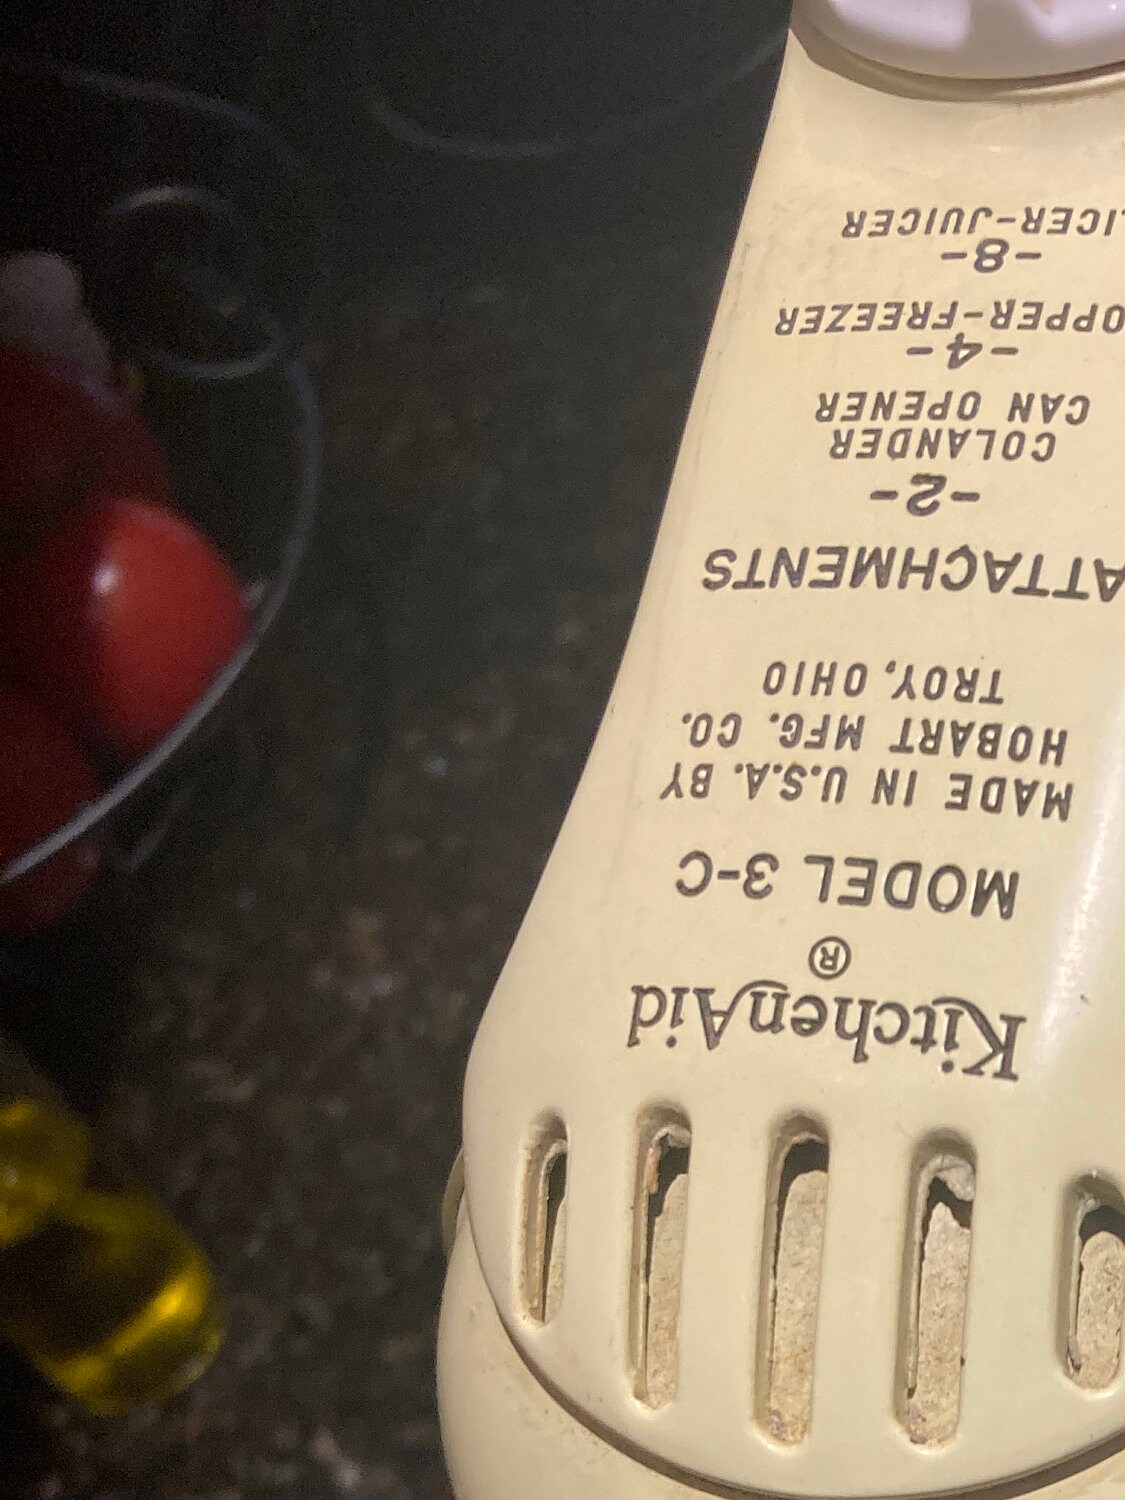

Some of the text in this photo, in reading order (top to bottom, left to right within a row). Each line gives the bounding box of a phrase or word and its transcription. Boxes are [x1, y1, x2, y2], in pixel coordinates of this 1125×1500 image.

[814, 389, 1091, 427] CAN OPENER
[828, 427, 1057, 463] COLANDER
[762, 659, 1005, 706] TROY, OHIO
[681, 711, 1068, 768] HOBART MFG. CO.
[659, 761, 1075, 823] MADE IN U.S.A. BY
[675, 849, 1020, 921] MODEL 3-C
[626, 979, 1028, 1082] KitchenAid
